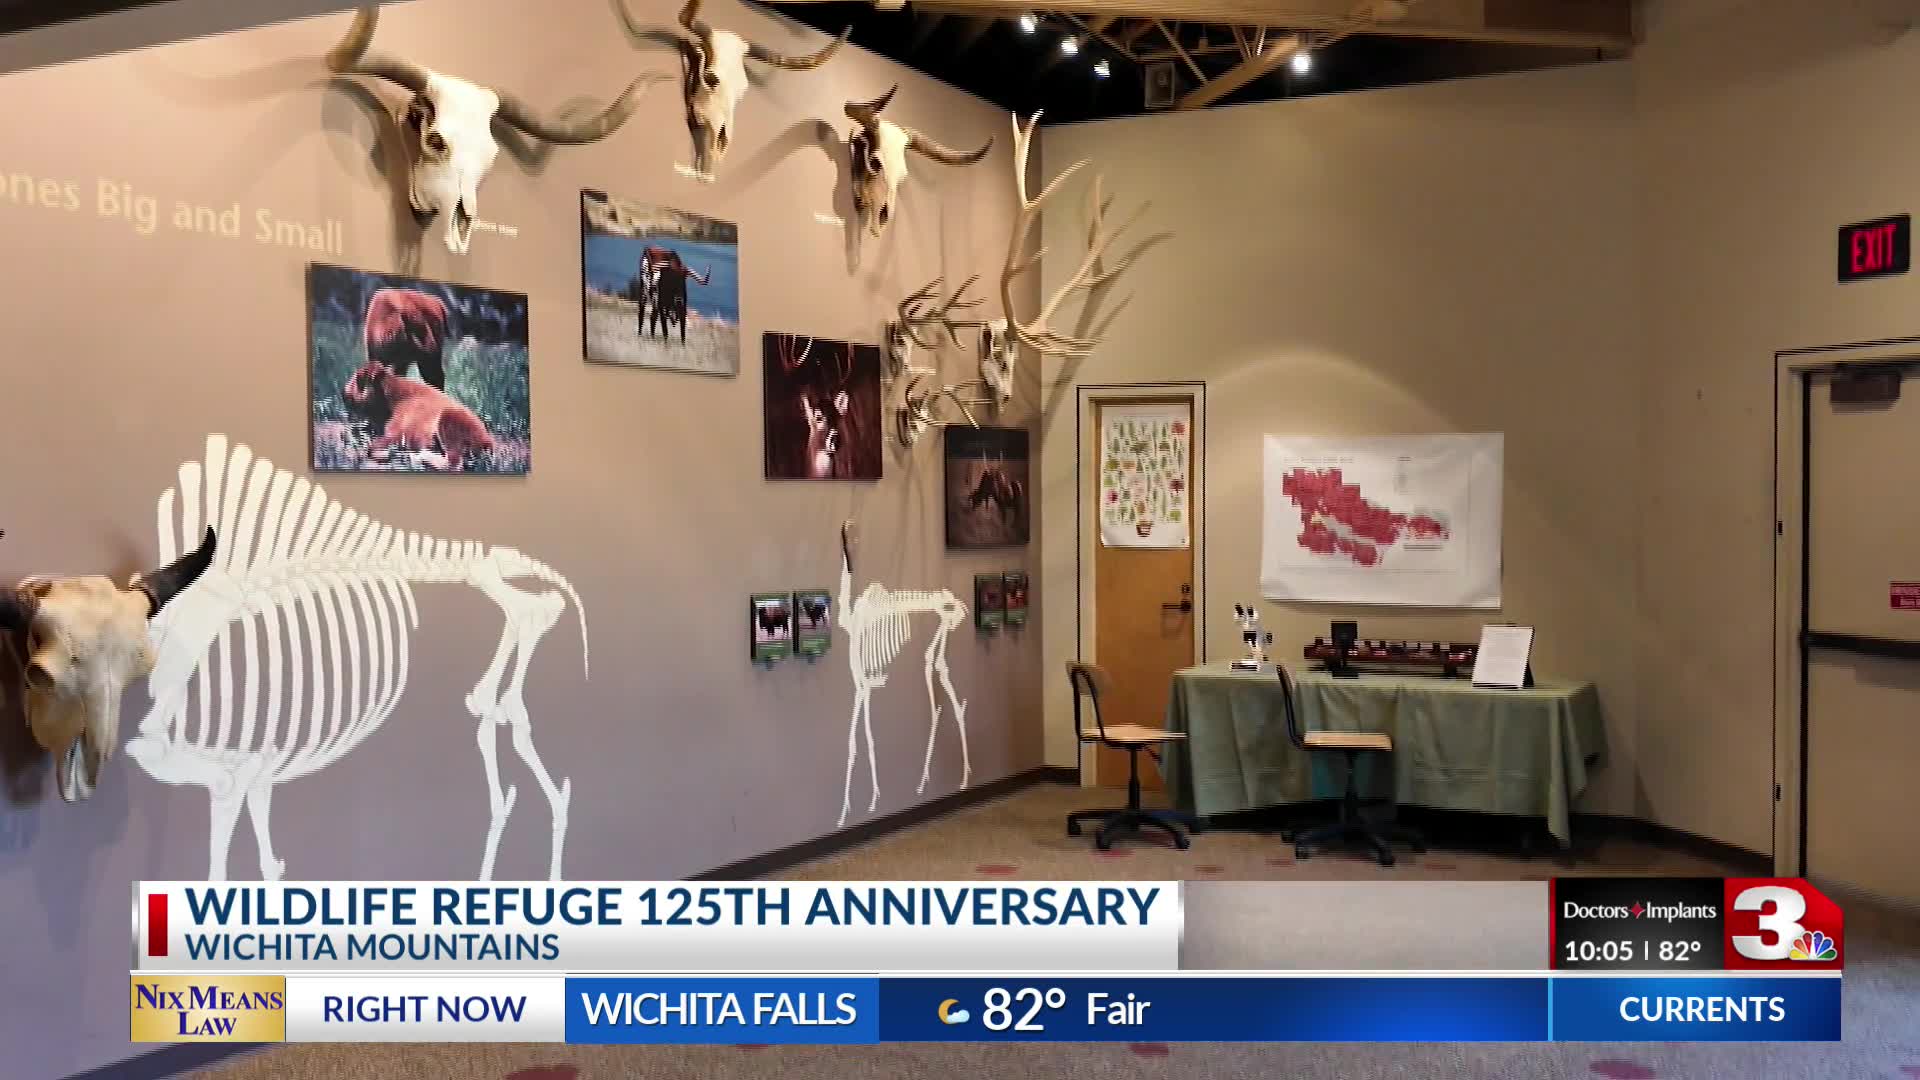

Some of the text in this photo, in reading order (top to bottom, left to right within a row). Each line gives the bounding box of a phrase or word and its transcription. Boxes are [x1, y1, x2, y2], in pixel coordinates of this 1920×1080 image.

[0, 171, 343, 255] nes Big and Small
[1851, 223, 1896, 272] EXIT
